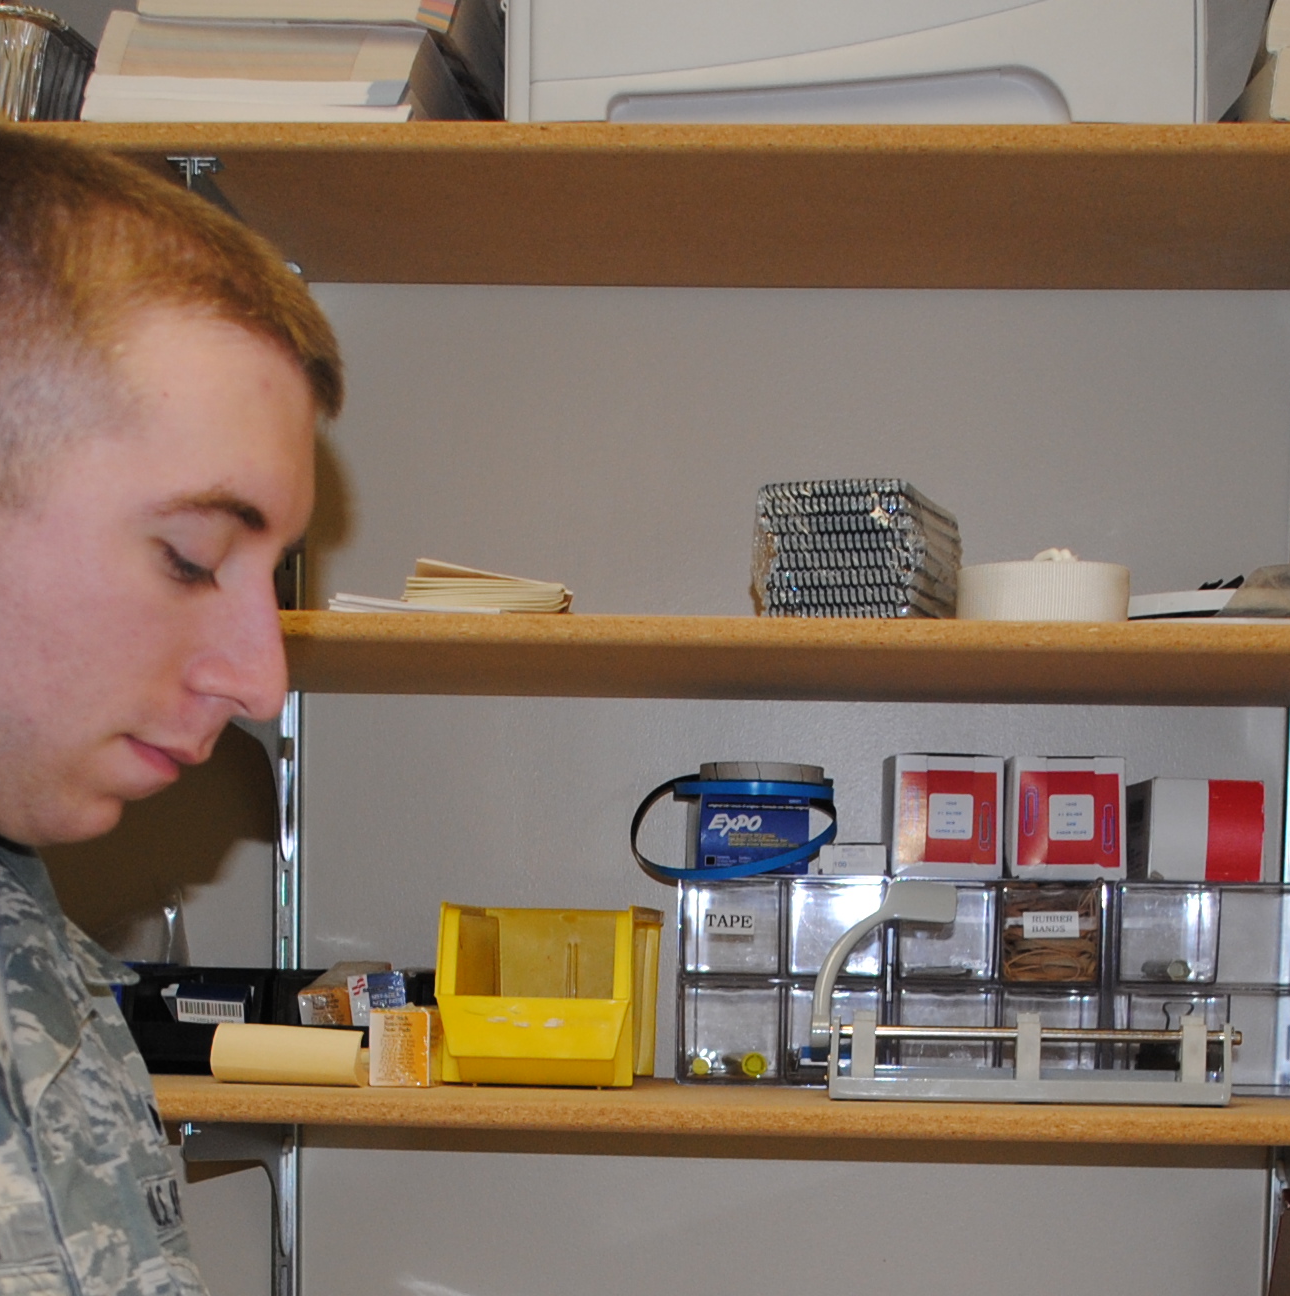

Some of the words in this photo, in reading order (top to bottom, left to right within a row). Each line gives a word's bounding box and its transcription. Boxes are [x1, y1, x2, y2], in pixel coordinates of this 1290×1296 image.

[708, 814, 762, 837] EXPO
[706, 914, 752, 929] TAPE
[1032, 915, 1073, 924] RUBBER
[1032, 925, 1066, 933] BANDS
